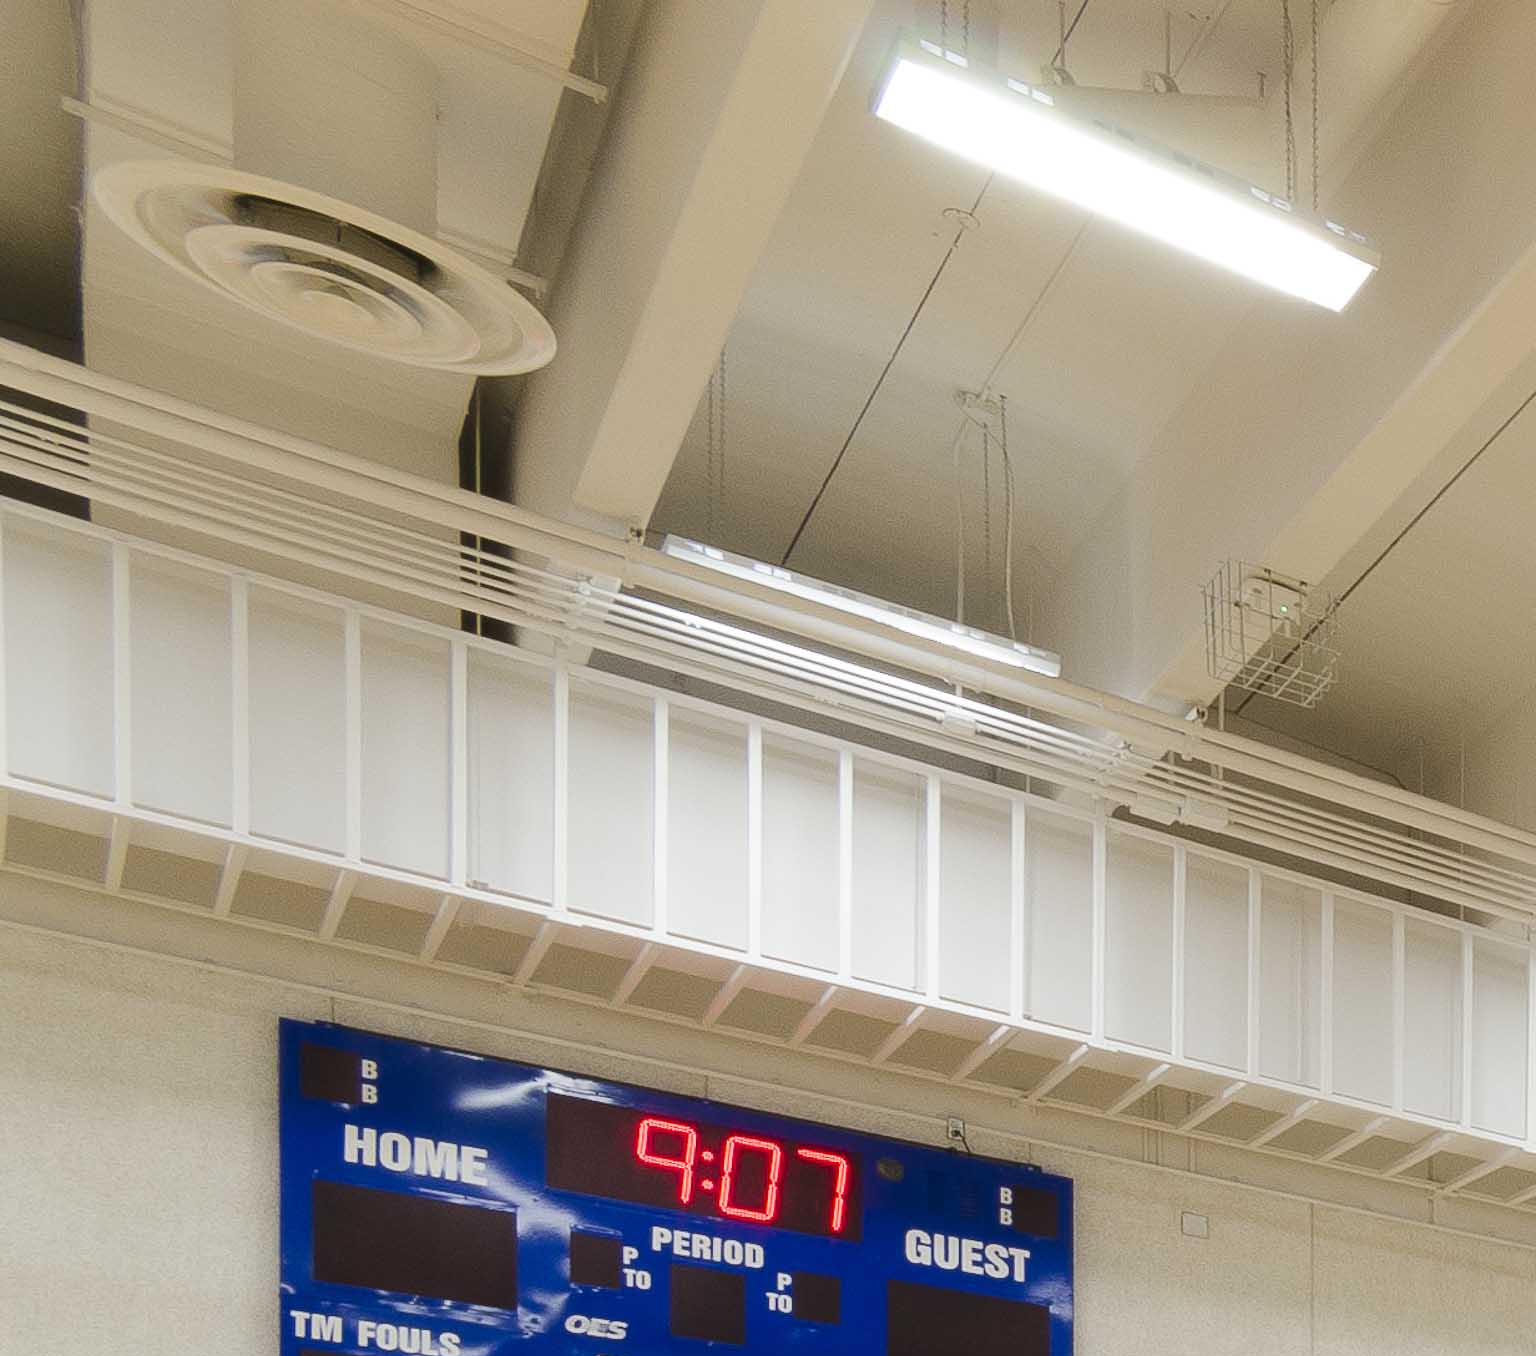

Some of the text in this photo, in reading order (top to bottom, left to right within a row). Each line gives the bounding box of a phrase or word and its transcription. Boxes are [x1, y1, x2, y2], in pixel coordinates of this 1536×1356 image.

[361, 1060, 378, 1079] B
[361, 1084, 378, 1104] B
[343, 1124, 489, 1187] HOME
[636, 1118, 847, 1232] 9:07
[1000, 1187, 1013, 1205] B
[1000, 1208, 1013, 1226] B
[622, 1246, 639, 1265] P
[652, 1226, 765, 1269] PERIOD
[905, 1229, 1031, 1282] GUEST
[623, 1268, 652, 1290] TO
[777, 1272, 792, 1291] P
[766, 1292, 792, 1314] TO
[290, 1310, 343, 1344] TM
